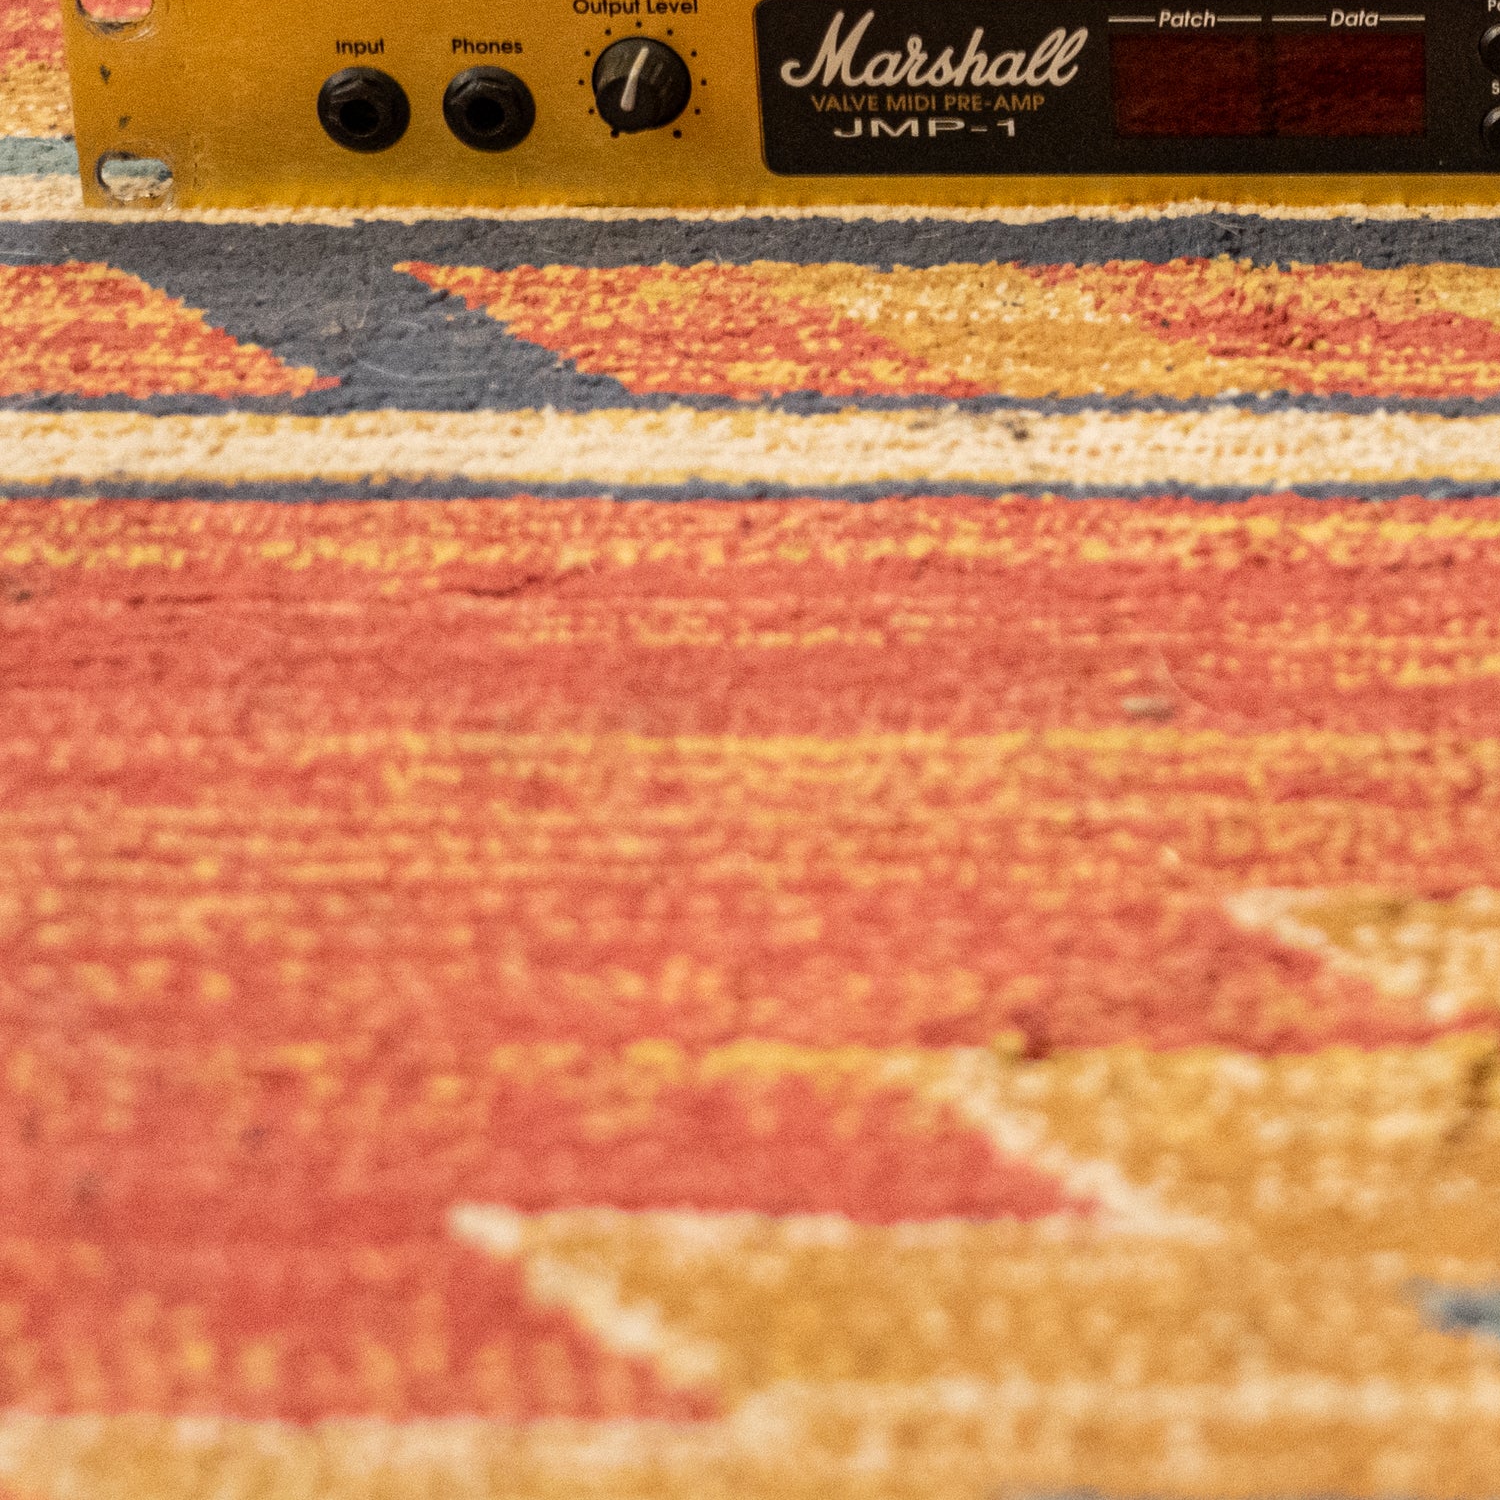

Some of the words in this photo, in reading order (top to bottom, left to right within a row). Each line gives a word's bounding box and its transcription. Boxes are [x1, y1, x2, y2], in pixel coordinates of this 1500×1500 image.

[1159, 9, 1216, 28] Patch
[1330, 8, 1379, 27] Data
[335, 39, 385, 57] Input
[451, 38, 523, 56] Phones
[780, 9, 1089, 87] Marshall
[811, 94, 879, 112] VALVE
[887, 94, 937, 112] MIDI
[945, 93, 1045, 112] PRE-AMP
[833, 116, 1016, 138] JMP-1
